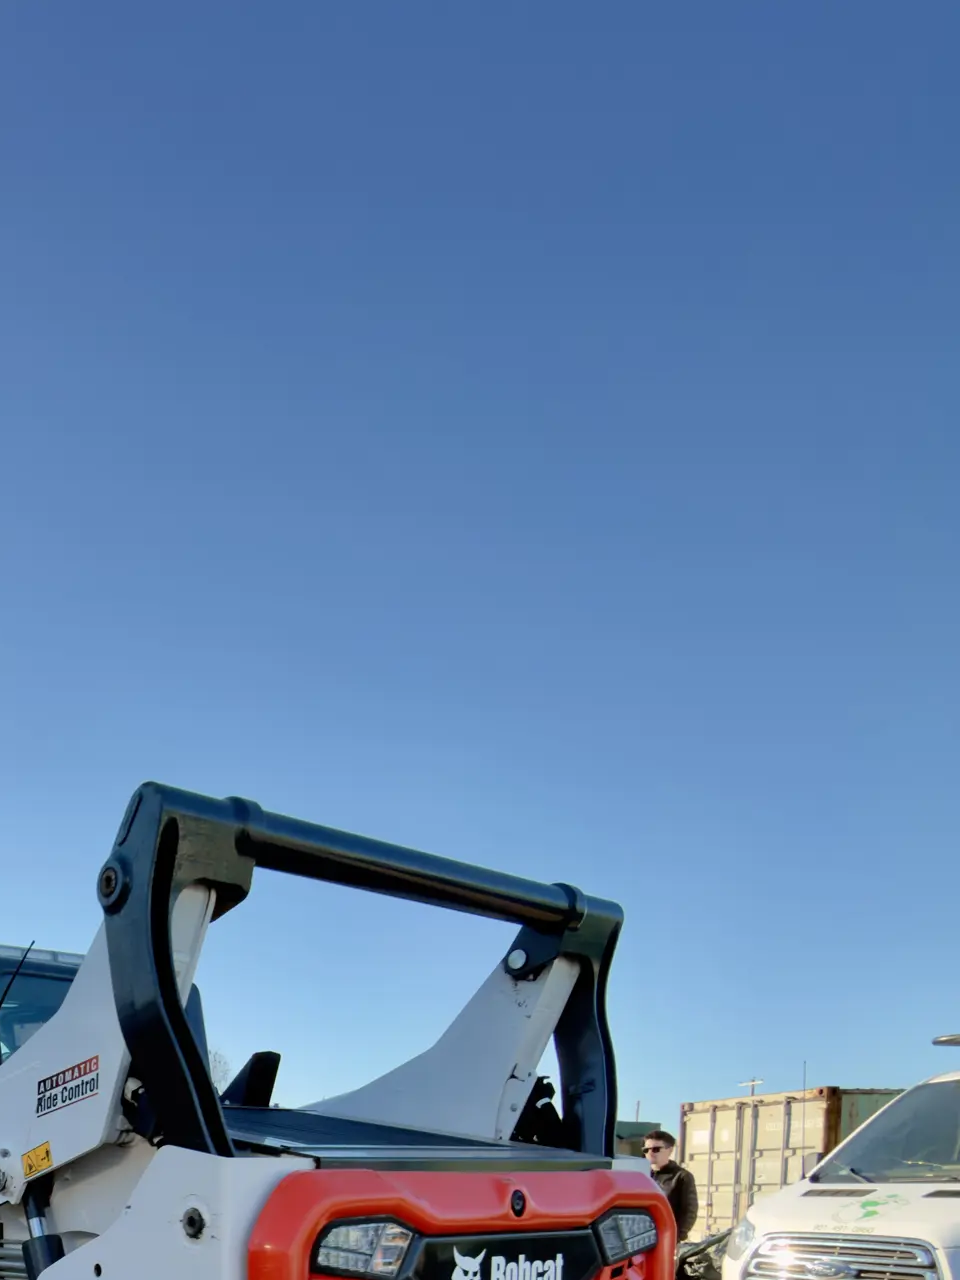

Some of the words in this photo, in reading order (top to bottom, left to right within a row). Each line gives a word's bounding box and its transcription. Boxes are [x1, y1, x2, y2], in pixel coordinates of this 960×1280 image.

[36, 1092, 59, 1114] Ride
[61, 1072, 99, 1104] Control
[39, 1057, 98, 1094] AUTOMATIC
